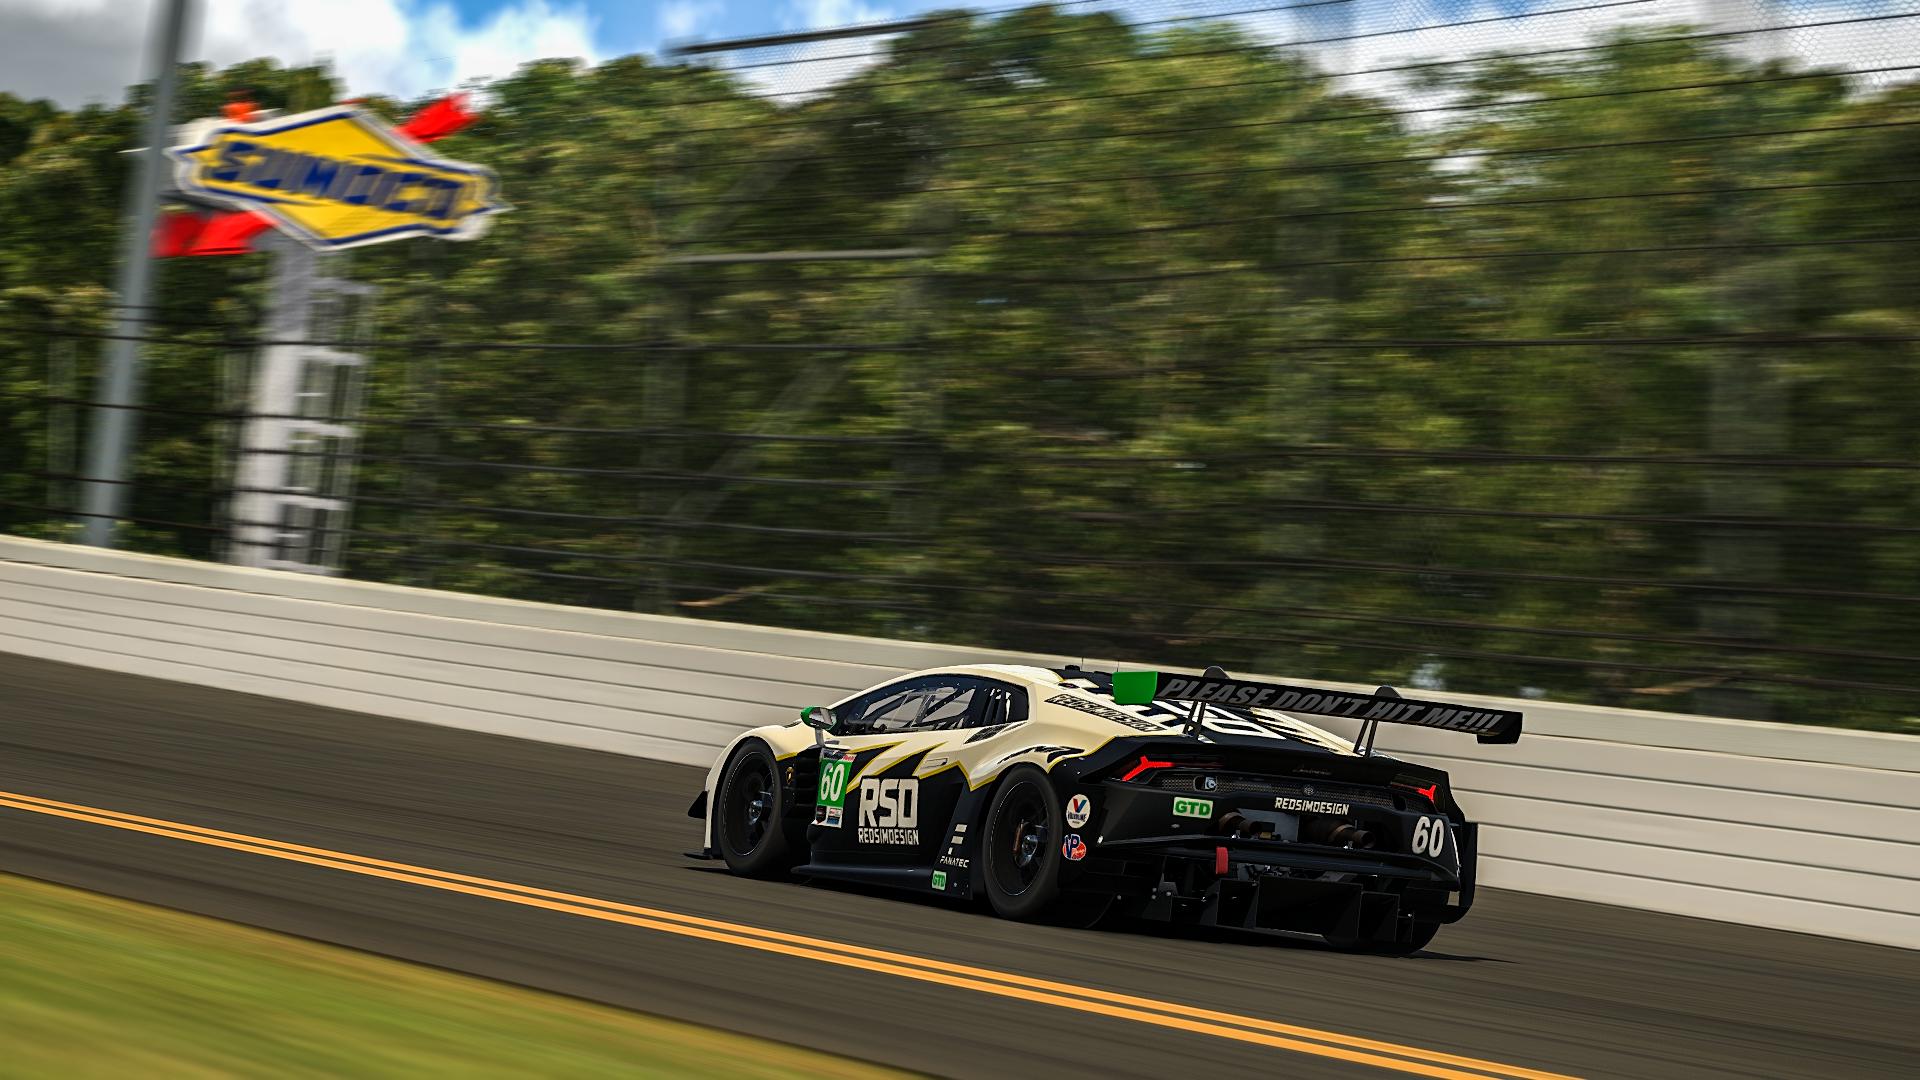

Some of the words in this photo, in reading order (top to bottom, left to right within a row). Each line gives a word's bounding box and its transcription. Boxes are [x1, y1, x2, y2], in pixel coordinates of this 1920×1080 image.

[1157, 678, 1275, 706] PLEASE
[1270, 690, 1370, 715] DON'T
[1364, 701, 1426, 722] HIT
[1420, 707, 1504, 732] ME!!!
[821, 762, 845, 802] 60
[858, 778, 919, 828] RSD
[1175, 801, 1211, 817] GTD
[1274, 797, 1350, 816] REDSIMDESIGN
[858, 827, 920, 845] REDSIMDESIGN
[1411, 816, 1445, 858] 60
[939, 855, 970, 868] FANATEC
[932, 873, 946, 888] GTD
